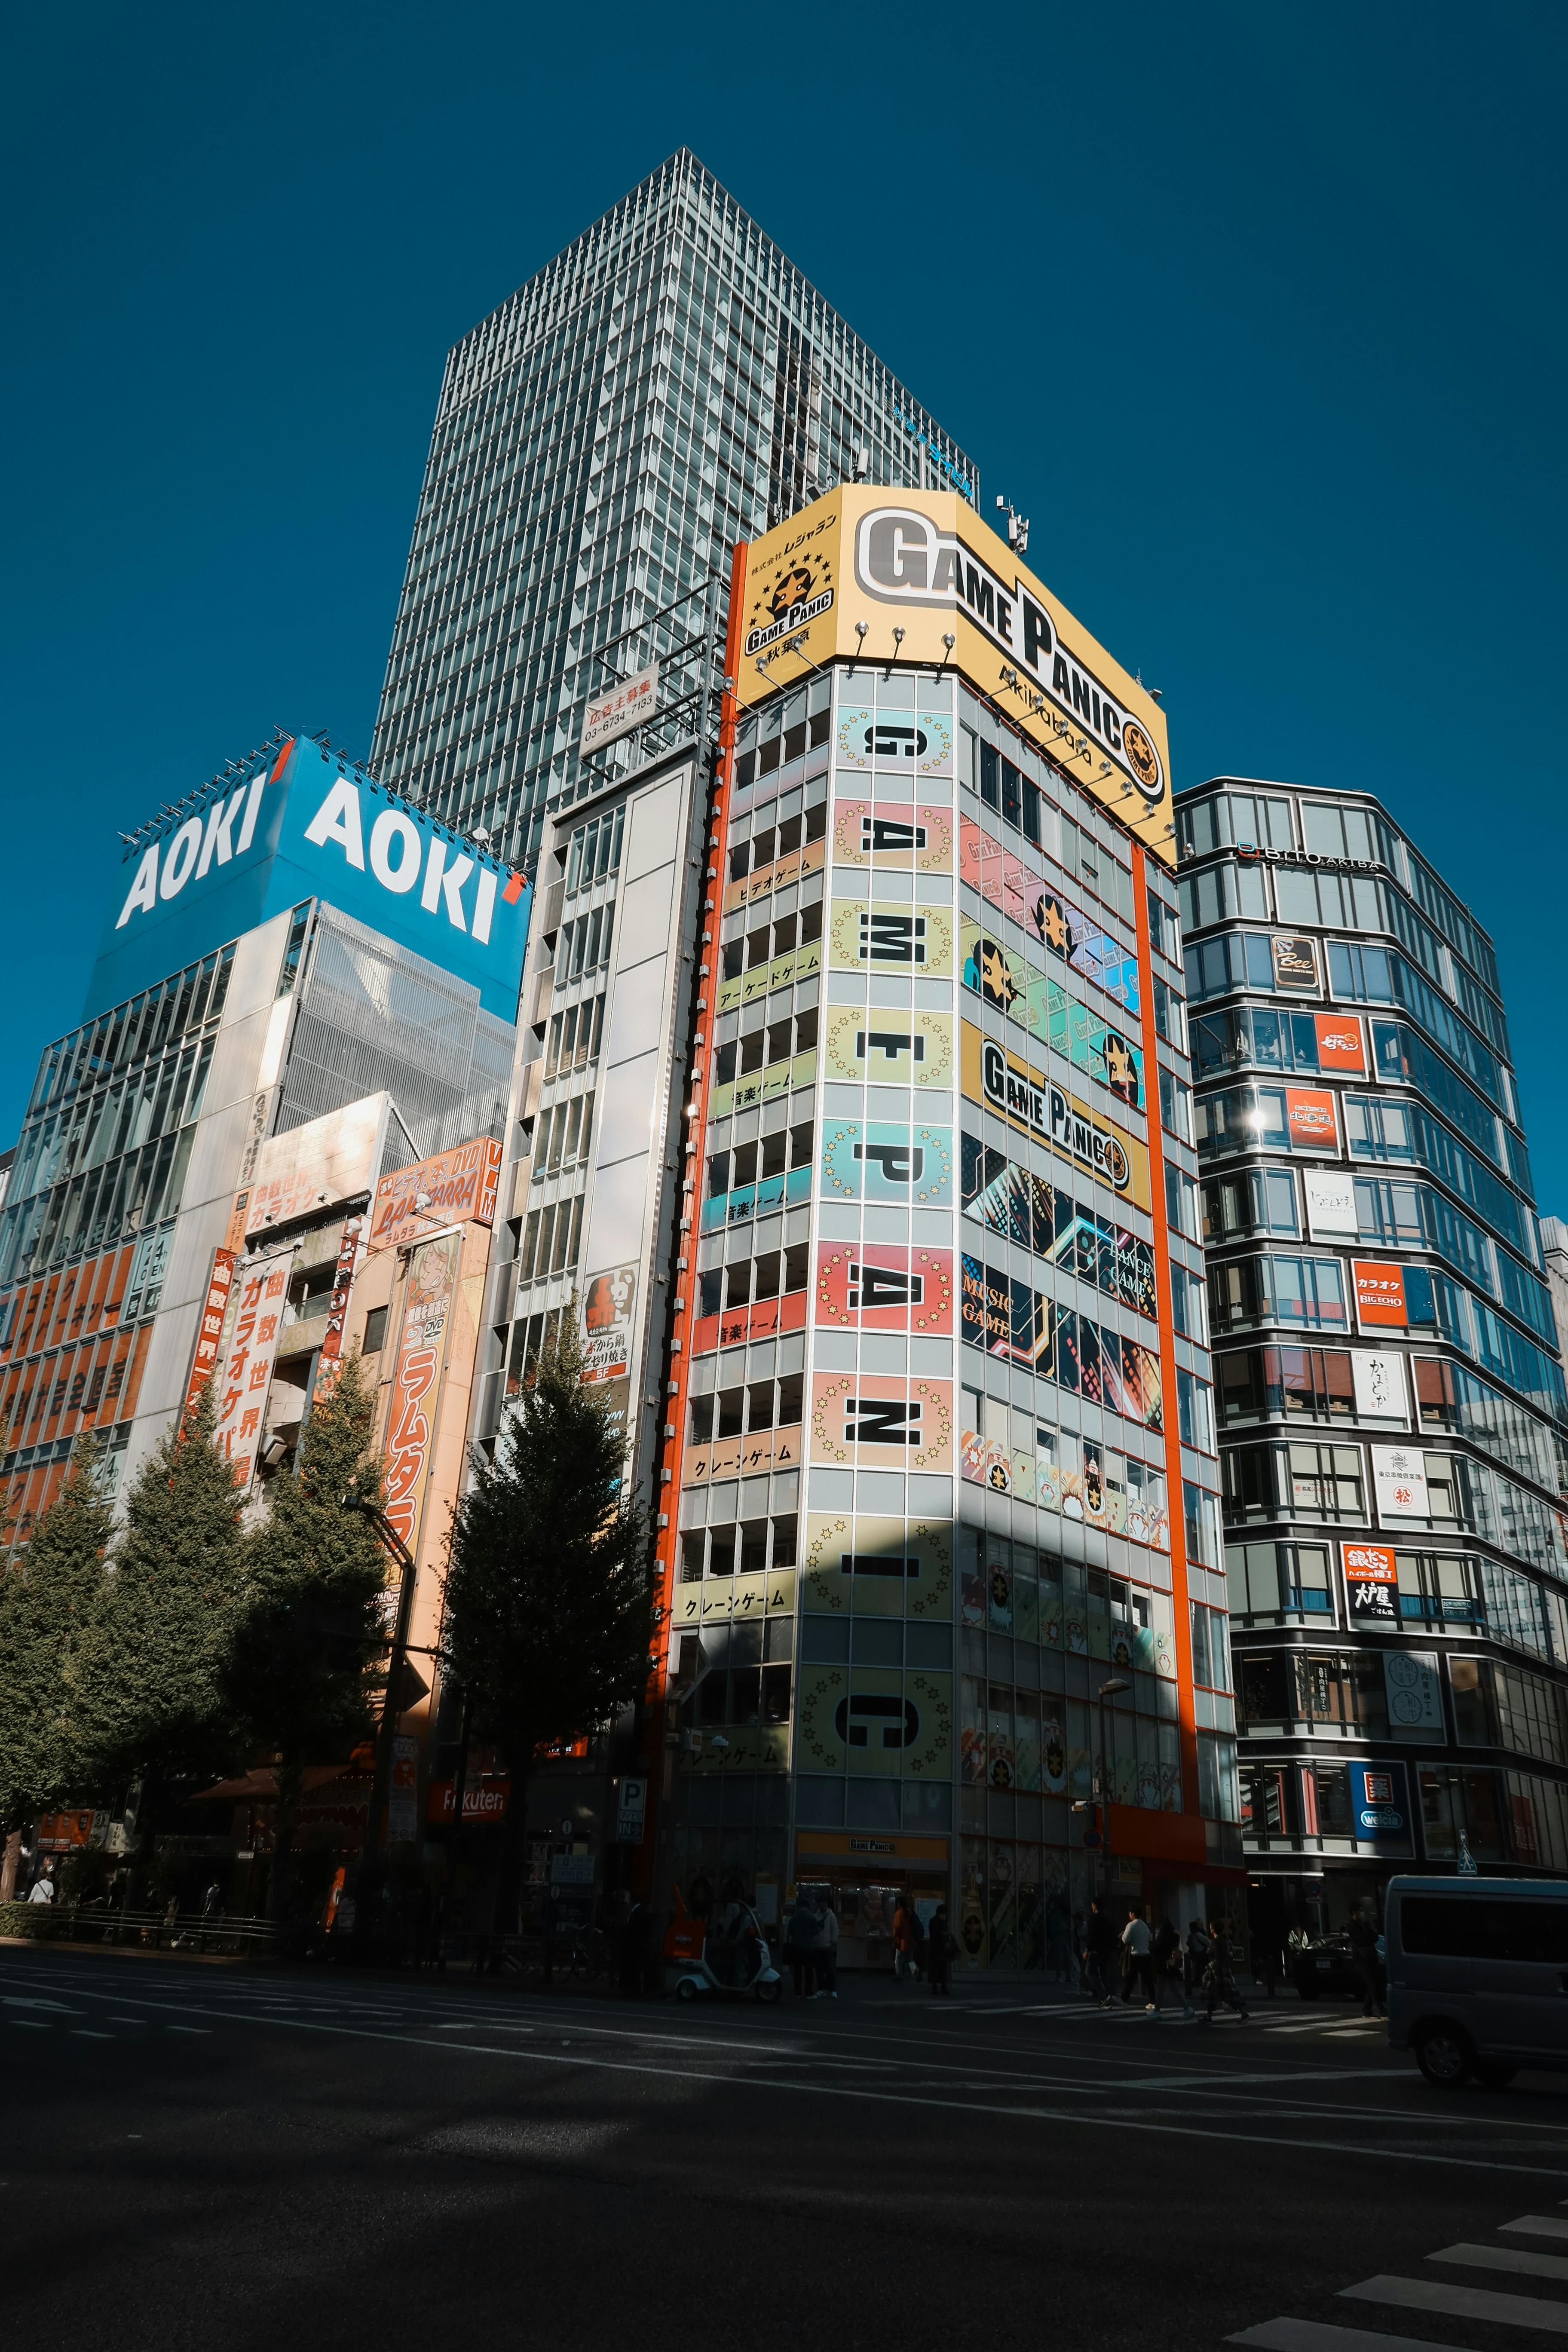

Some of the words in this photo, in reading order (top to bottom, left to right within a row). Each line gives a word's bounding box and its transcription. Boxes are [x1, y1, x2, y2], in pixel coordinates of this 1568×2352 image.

[751, 551, 782, 576] 株式会社
[784, 514, 837, 555] レジャラン
[747, 621, 784, 653] GAME
[789, 594, 830, 628] PANIC
[868, 525, 1013, 646] GAME
[1024, 591, 1122, 753] PANIC
[767, 626, 810, 664] 秋葉原
[585, 694, 652, 742] 03-6734-7133
[589, 679, 651, 726] 広告主募集
[115, 772, 267, 930] AOKI
[304, 777, 498, 945] AOKI
[1326, 856, 1379, 870] AKIBA
[1277, 952, 1313, 969] Bee
[721, 956, 819, 1007] アーケードゲーム
[732, 1073, 794, 1106] 音楽ゲーム
[984, 1045, 1043, 1125] GAME
[1050, 1088, 1104, 1165] PANIC
[1290, 1112, 1332, 1124] 北海道
[249, 1185, 319, 1230] カラオケ
[373, 1170, 478, 1238] LAMTARRA
[724, 1190, 789, 1221] 音楽ゲーム
[141, 1263, 165, 1281] OEN
[1109, 1241, 1151, 1278] DANCE
[962, 1274, 1014, 1314] MUSIC
[1110, 1265, 1147, 1298] GAME
[1358, 1279, 1400, 1290] カラオケ
[1360, 1295, 1377, 1304] BIG
[1378, 1296, 1403, 1307] ECHO
[425, 1318, 444, 1332] DVD
[716, 1314, 783, 1343] 音楽ゲーム
[962, 1302, 1010, 1339] GAME
[596, 1368, 609, 1379] 5F
[1369, 1359, 1386, 1408] かまどか
[385, 1345, 438, 1551] ラムタラ
[695, 1445, 791, 1477] クレーンゲーム
[1395, 1488, 1411, 1503] 松
[1347, 1547, 1389, 1570] 銀だこ
[1348, 1570, 1393, 1579] ハイボール横丁
[686, 1589, 785, 1617] クレーンゲーム
[1354, 1581, 1393, 1609] 大戸屋
[624, 1783, 640, 1806] P
[1368, 1776, 1389, 1799] 薬
[619, 1822, 632, 1834] IN
[621, 1812, 641, 1821] ダイビル
[1364, 1814, 1399, 1825] welcia
[851, 1838, 868, 1849] GAME
[870, 1840, 888, 1850] PANIC
